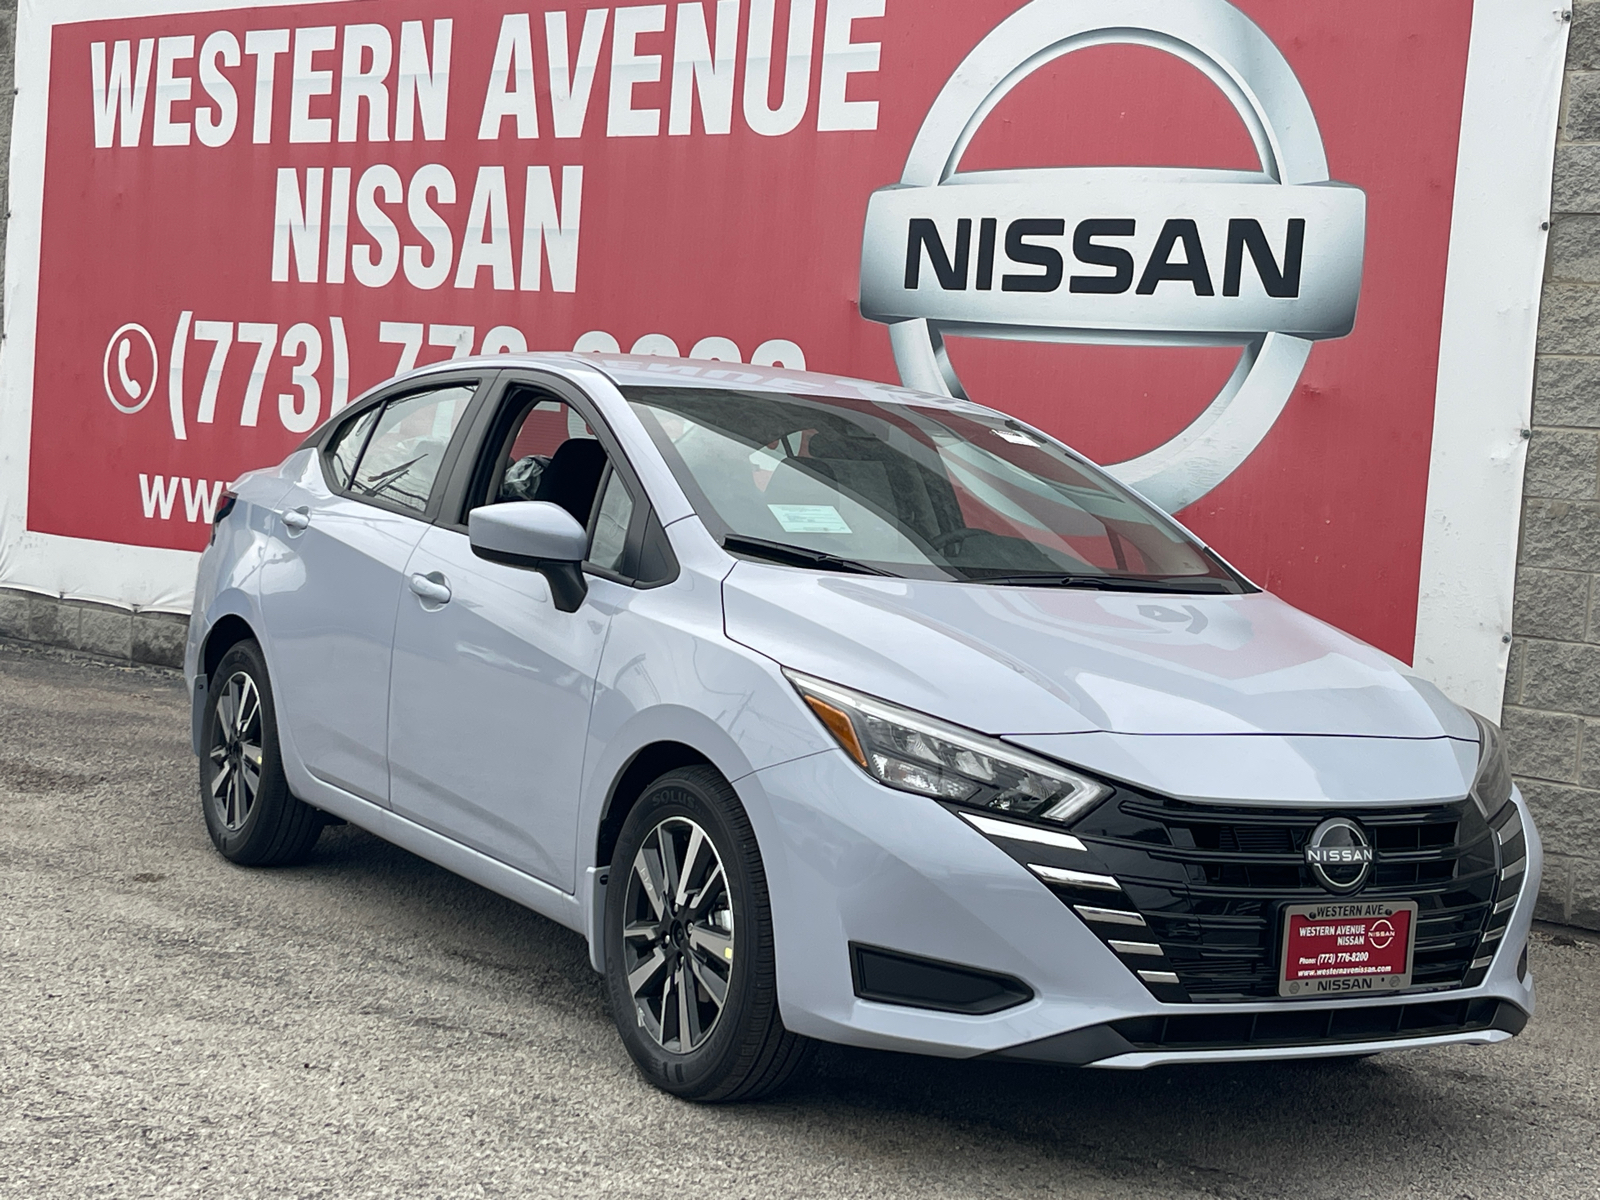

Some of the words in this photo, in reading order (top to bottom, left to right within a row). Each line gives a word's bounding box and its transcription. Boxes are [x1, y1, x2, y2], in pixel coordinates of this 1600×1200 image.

[91, 18, 453, 149] WESTERN
[478, 0, 886, 138] AVENUE
[271, 163, 584, 293] NISSAN
[904, 217, 1306, 299] NISSAN
[169, 310, 349, 440] (773)
[1308, 849, 1373, 861] NISSAN
[1317, 907, 1362, 917] WESTERN
[1364, 904, 1384, 915] AVE
[1299, 927, 1335, 936] WESTERN
[1336, 925, 1366, 934] AVENUE
[1337, 936, 1365, 946] NISSAN
[1317, 953, 1336, 966] (773)
[1337, 952, 1369, 962] 776-8200
[1298, 966, 1391, 976] www.westernavenissan.com
[1317, 978, 1372, 991] NISSAN
